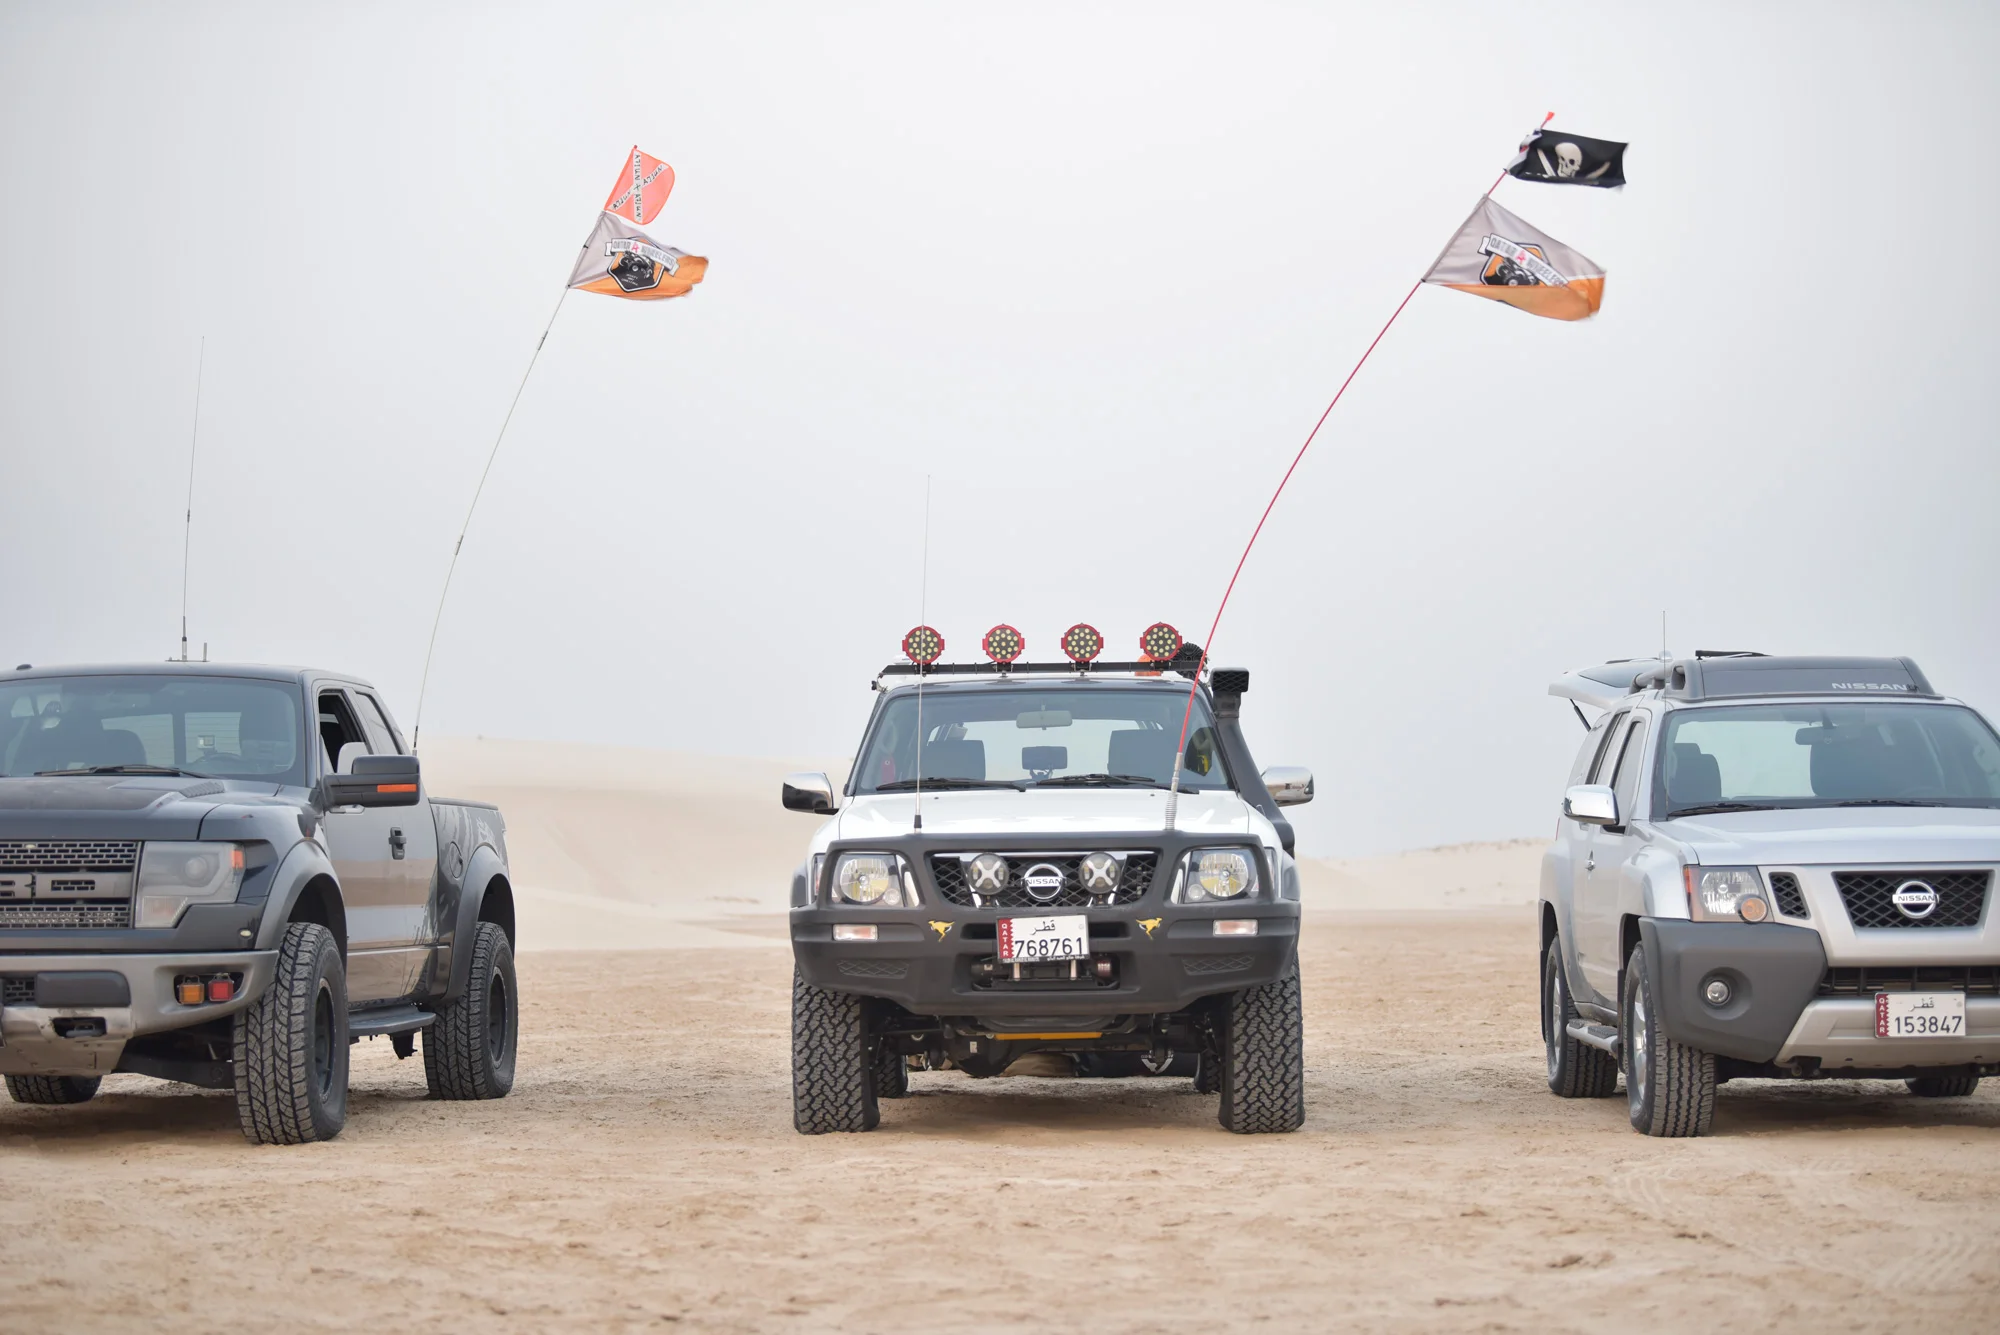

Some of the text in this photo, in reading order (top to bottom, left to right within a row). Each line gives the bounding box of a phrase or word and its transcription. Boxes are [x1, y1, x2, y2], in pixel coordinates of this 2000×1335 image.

[1831, 682, 1908, 691] NISSAN
[1030, 920, 1055, 935] قطر
[1001, 923, 1009, 957] QATAR
[1014, 937, 1082, 958] 768761
[1908, 997, 1934, 1012] قطر
[1894, 1016, 1962, 1034] 153847
